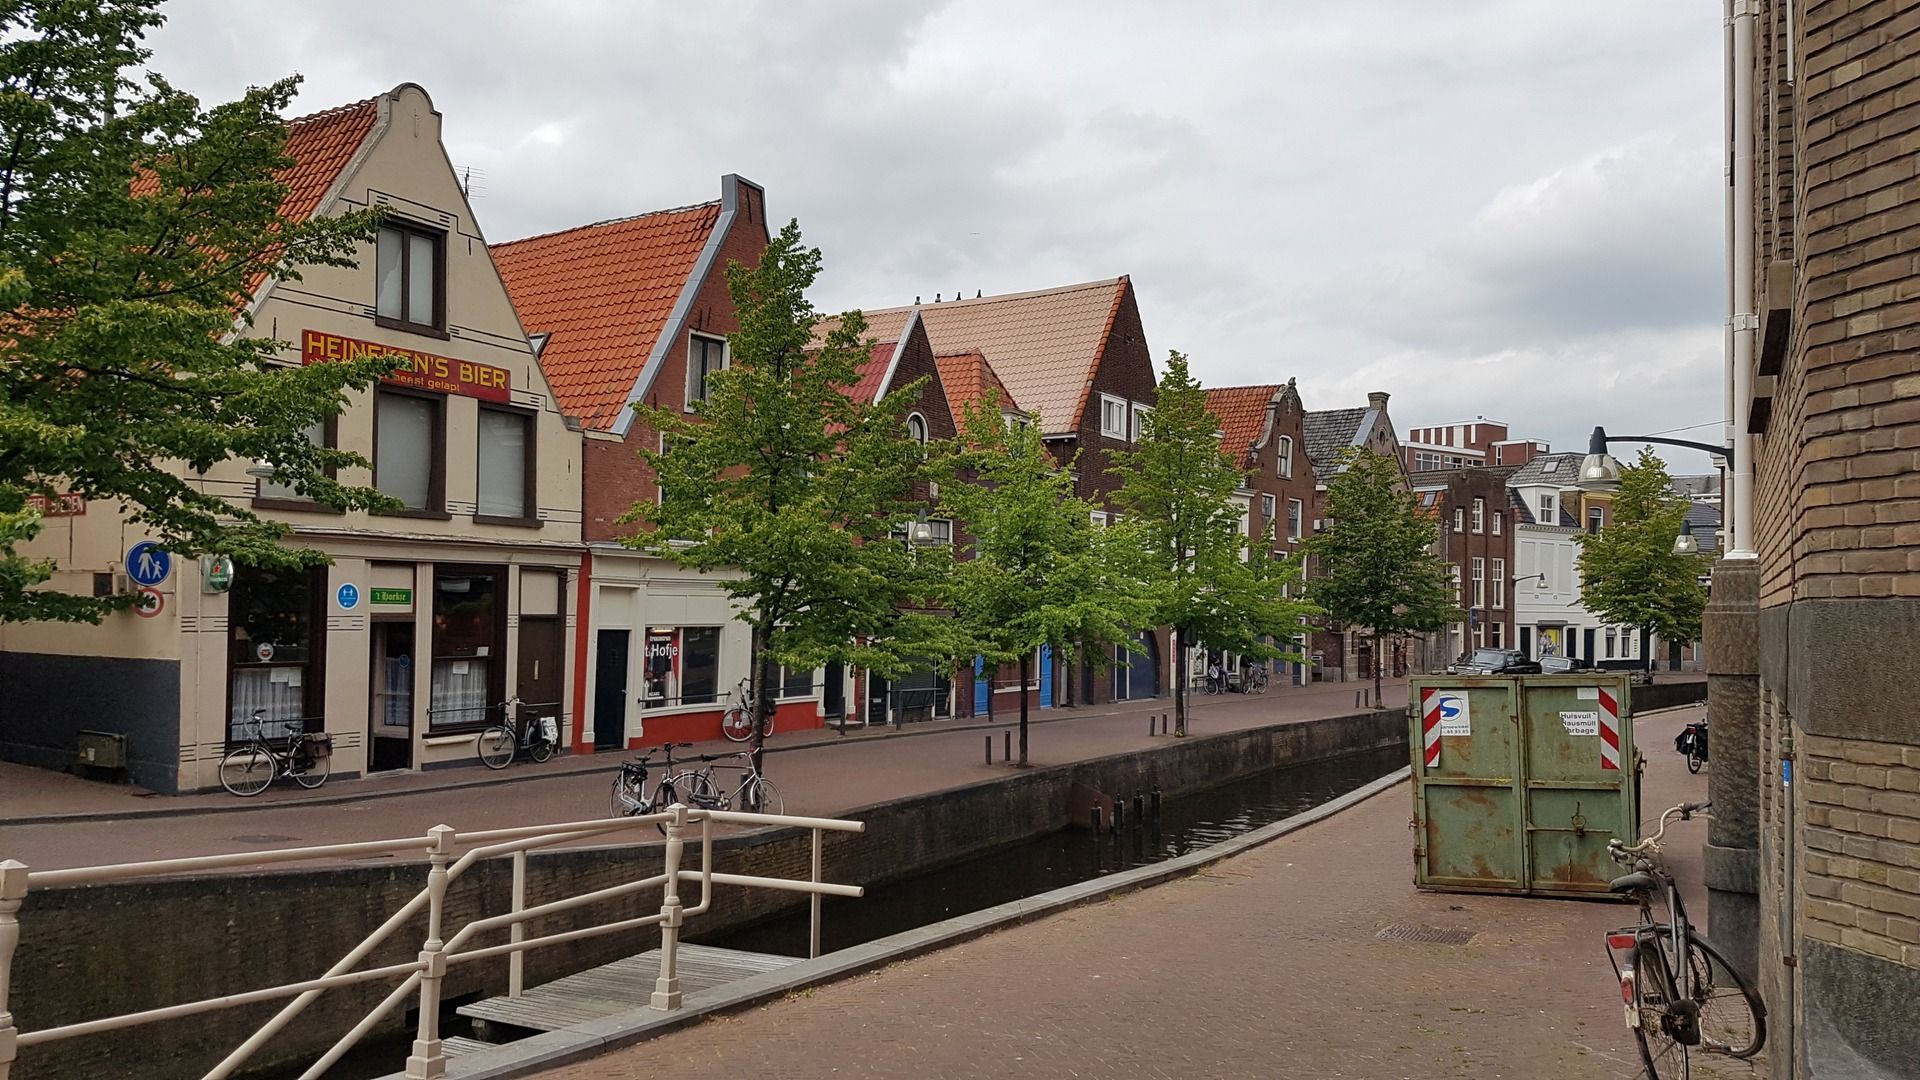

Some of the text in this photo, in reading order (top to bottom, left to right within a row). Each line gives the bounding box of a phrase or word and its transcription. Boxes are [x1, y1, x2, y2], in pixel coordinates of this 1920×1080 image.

[307, 333, 506, 389] HEINEN'S BIER
[651, 643, 678, 659] Hofje
